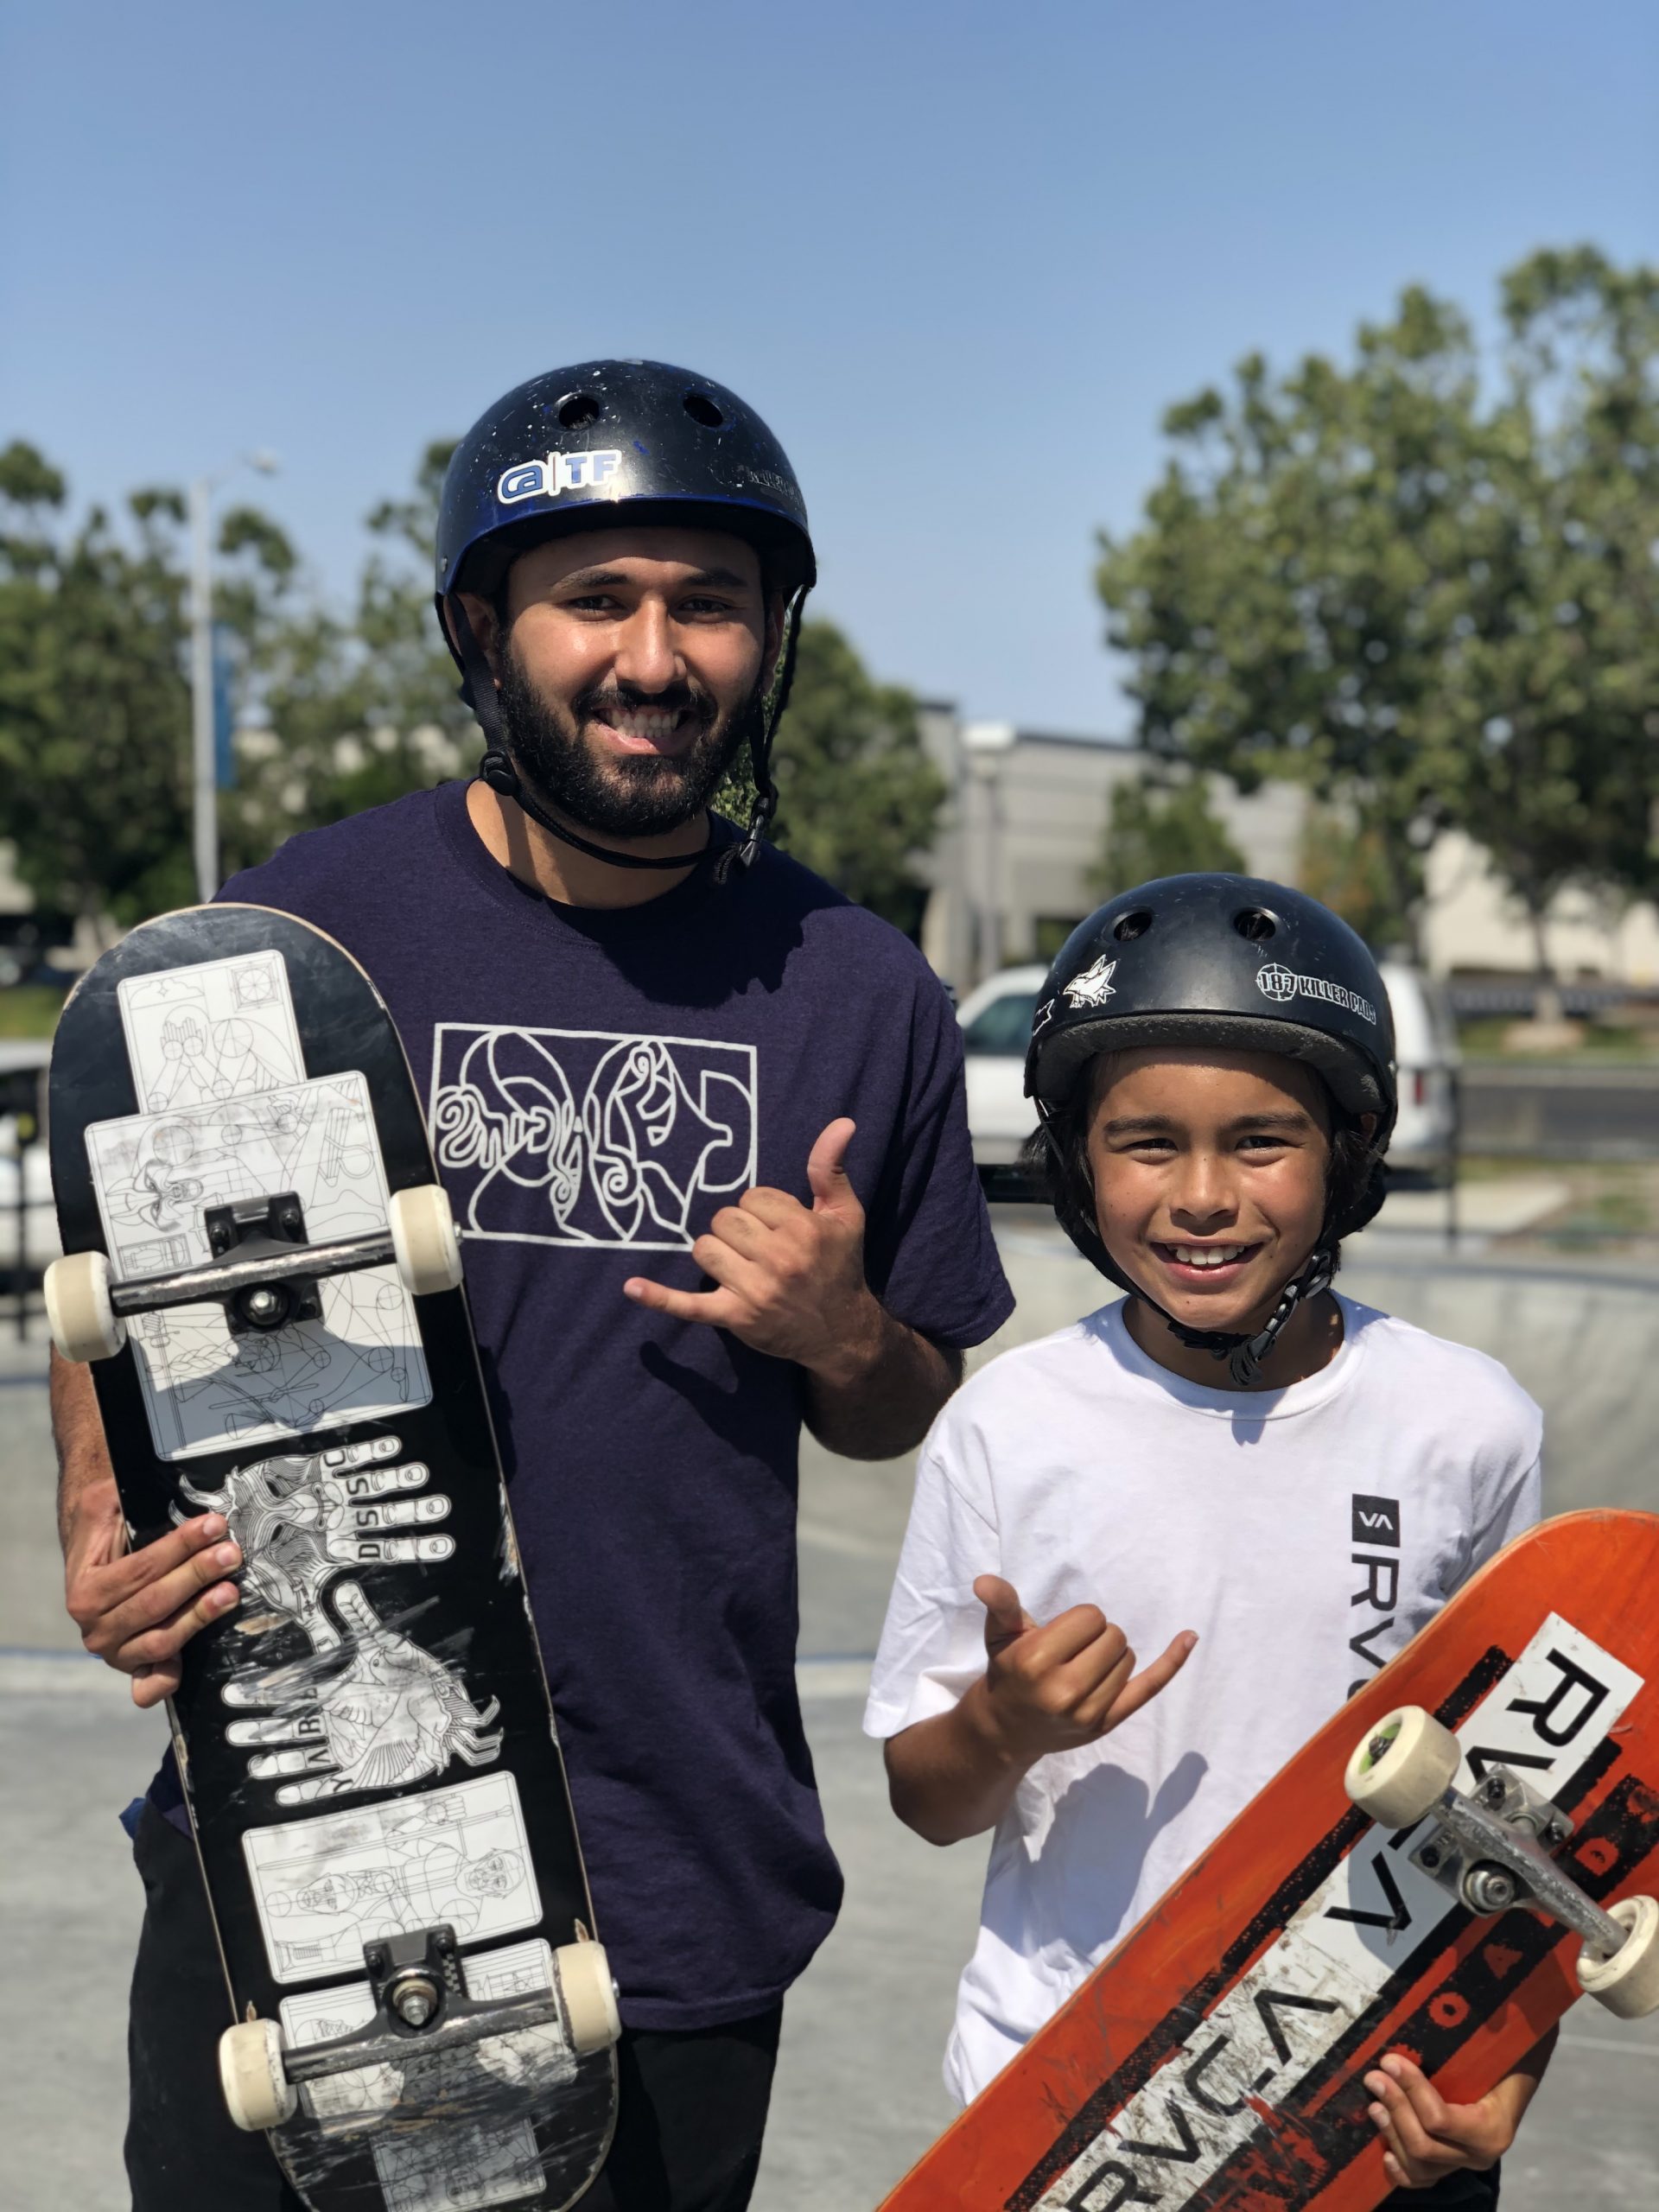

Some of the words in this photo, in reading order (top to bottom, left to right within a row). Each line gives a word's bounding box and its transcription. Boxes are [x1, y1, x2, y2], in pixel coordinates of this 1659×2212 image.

[1258, 971, 1297, 994] 187
[1298, 975, 1350, 1009] KILLER
[1349, 991, 1376, 1026] PADS
[1346, 1553, 1400, 1703] RV
[1323, 1648, 1611, 1931] RVA
[1062, 1988, 1340, 2212] RVCA
